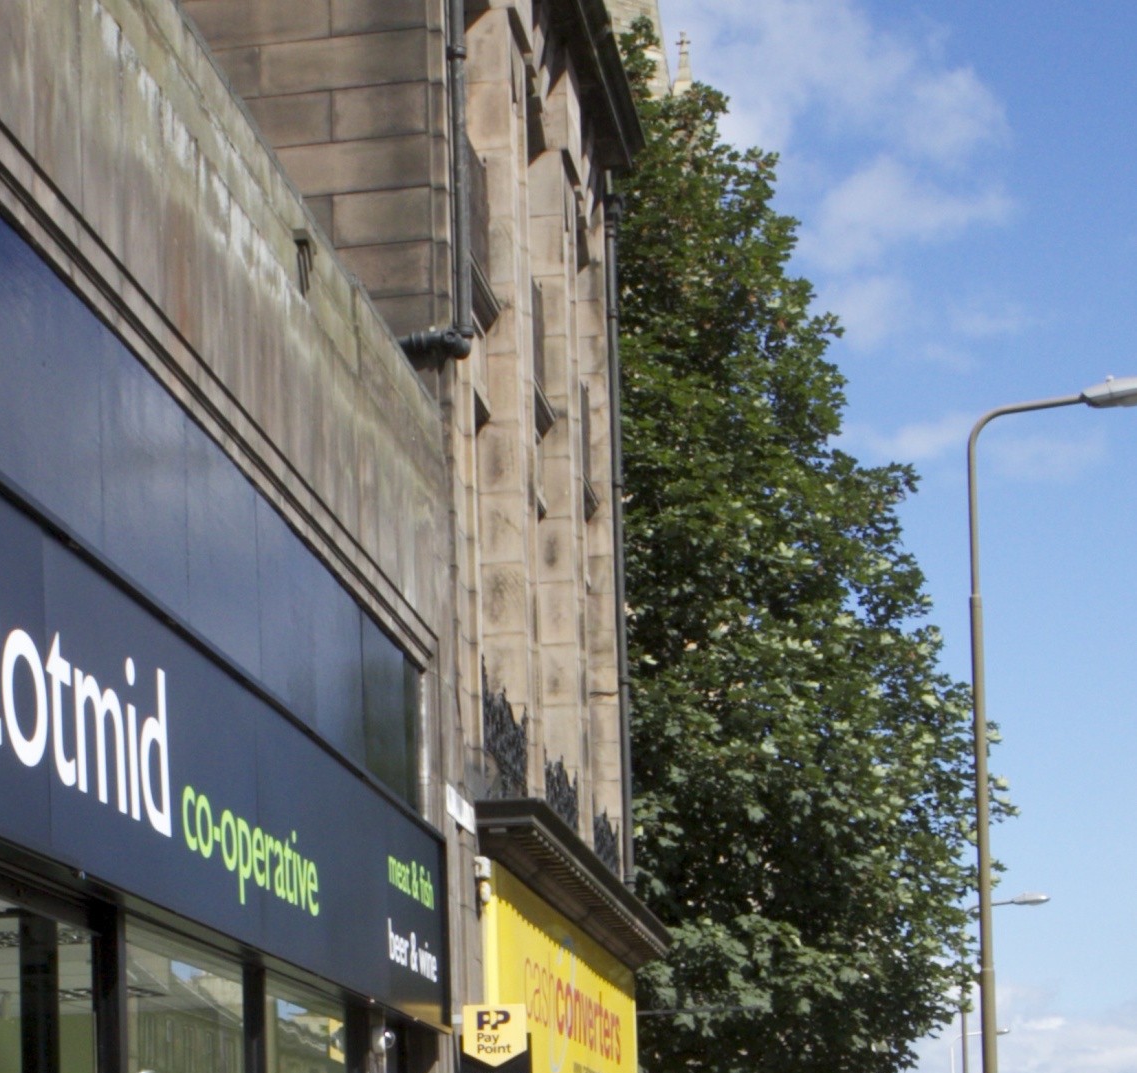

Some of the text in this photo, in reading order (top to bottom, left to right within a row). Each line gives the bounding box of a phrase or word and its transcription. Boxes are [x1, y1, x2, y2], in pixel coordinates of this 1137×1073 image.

[182, 785, 320, 917] co-operative
[388, 855, 435, 910] meat & fish
[388, 918, 437, 982] beer & wine
[477, 1032, 499, 1044] Pay
[477, 1044, 511, 1054] Point
